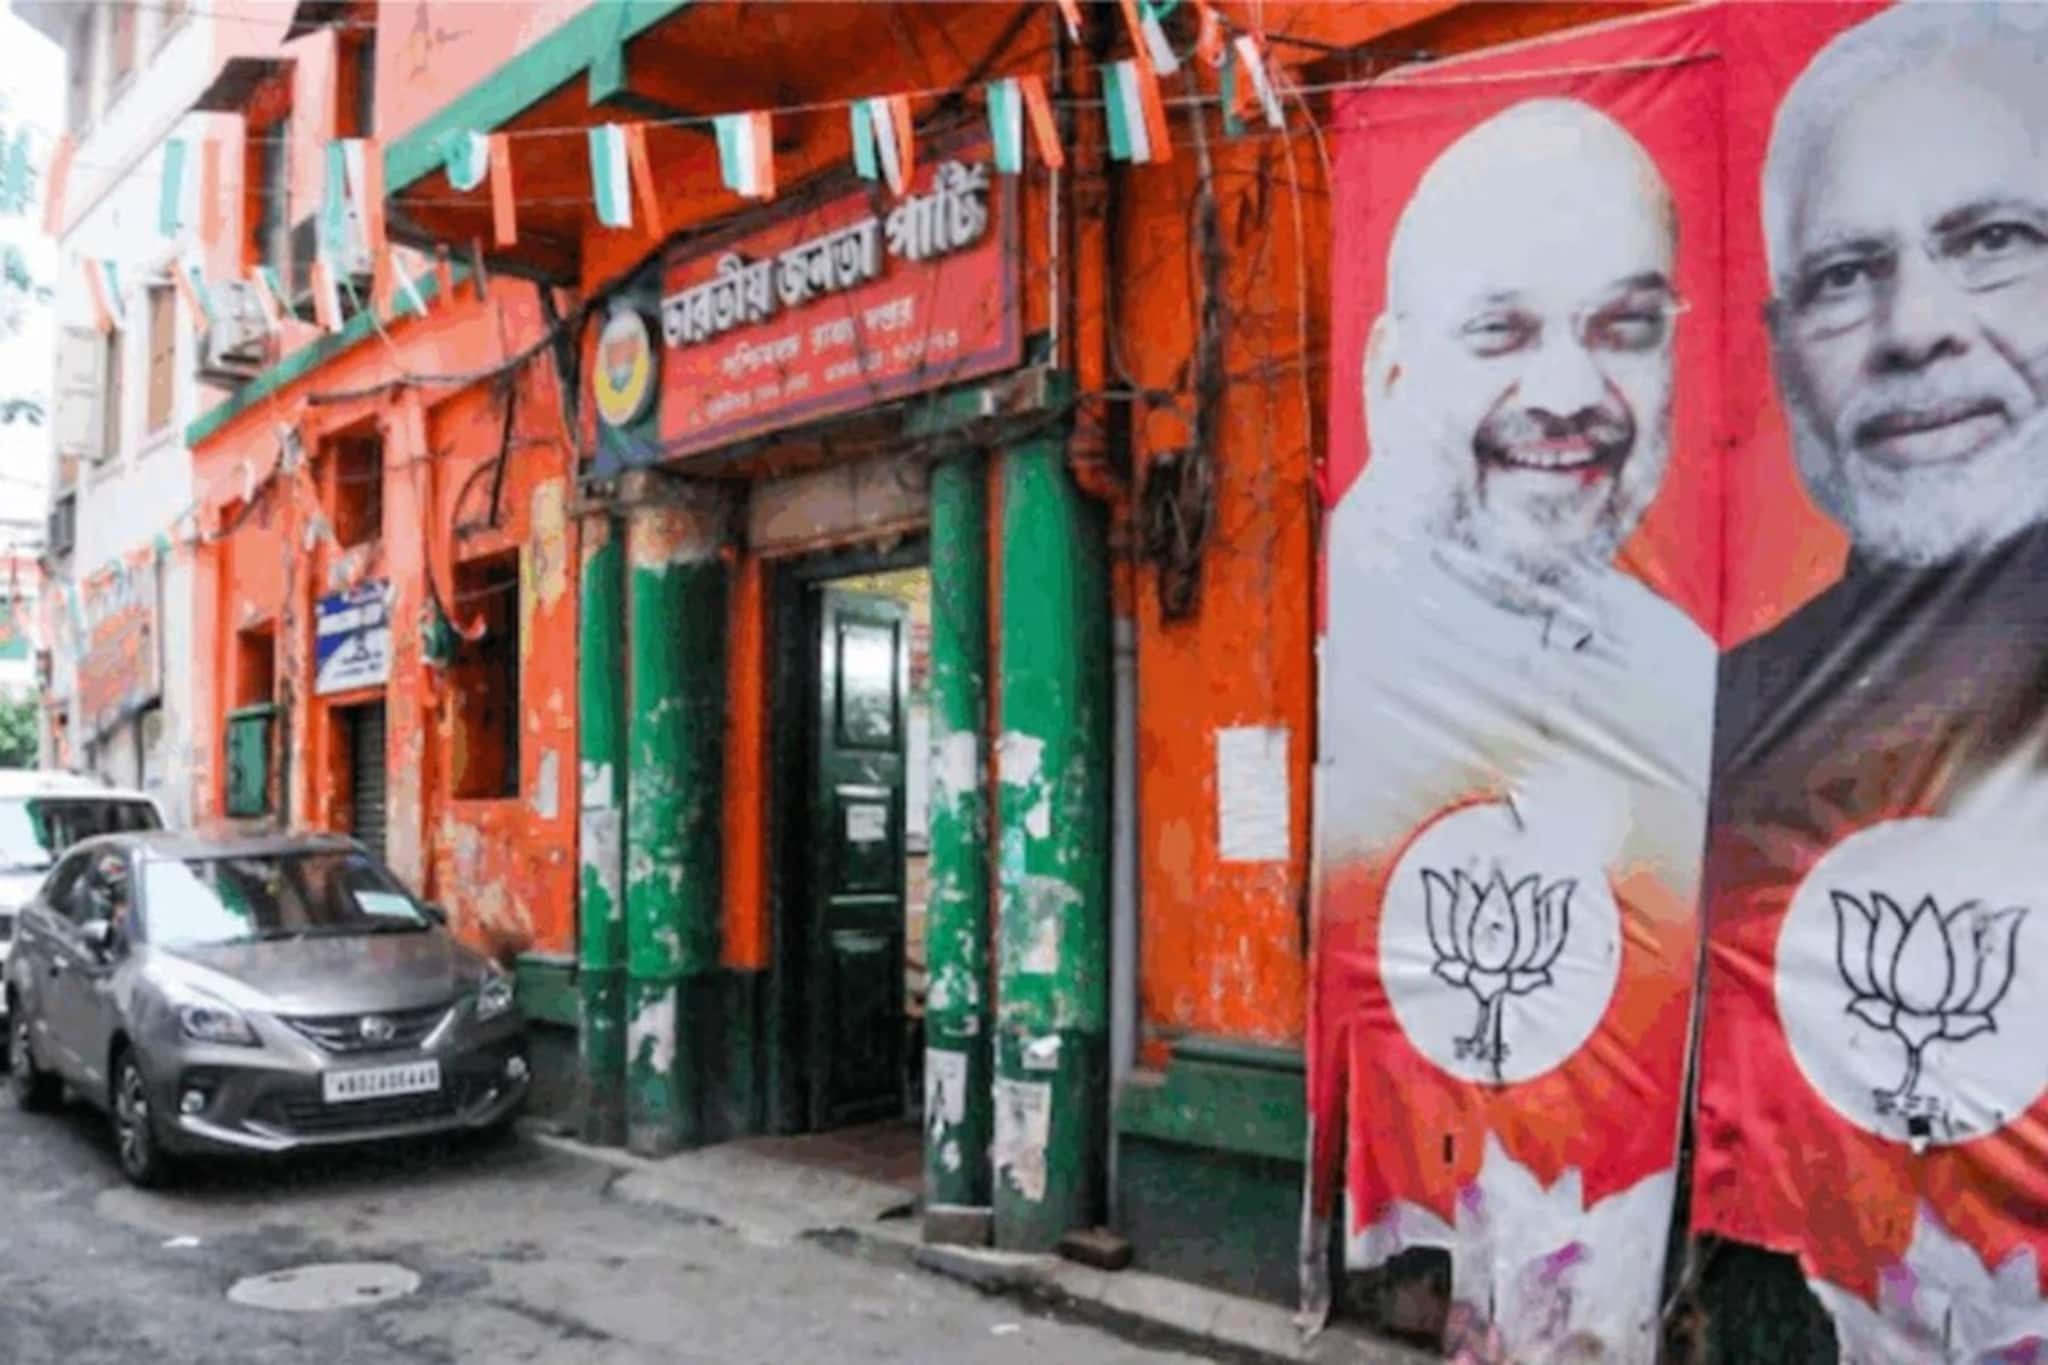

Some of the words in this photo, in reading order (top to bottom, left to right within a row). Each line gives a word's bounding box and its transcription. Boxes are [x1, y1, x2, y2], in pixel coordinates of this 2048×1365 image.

[660, 252, 773, 348] ভারতীয়
[777, 216, 880, 307] জনতা
[885, 160, 990, 260] পার্টি
